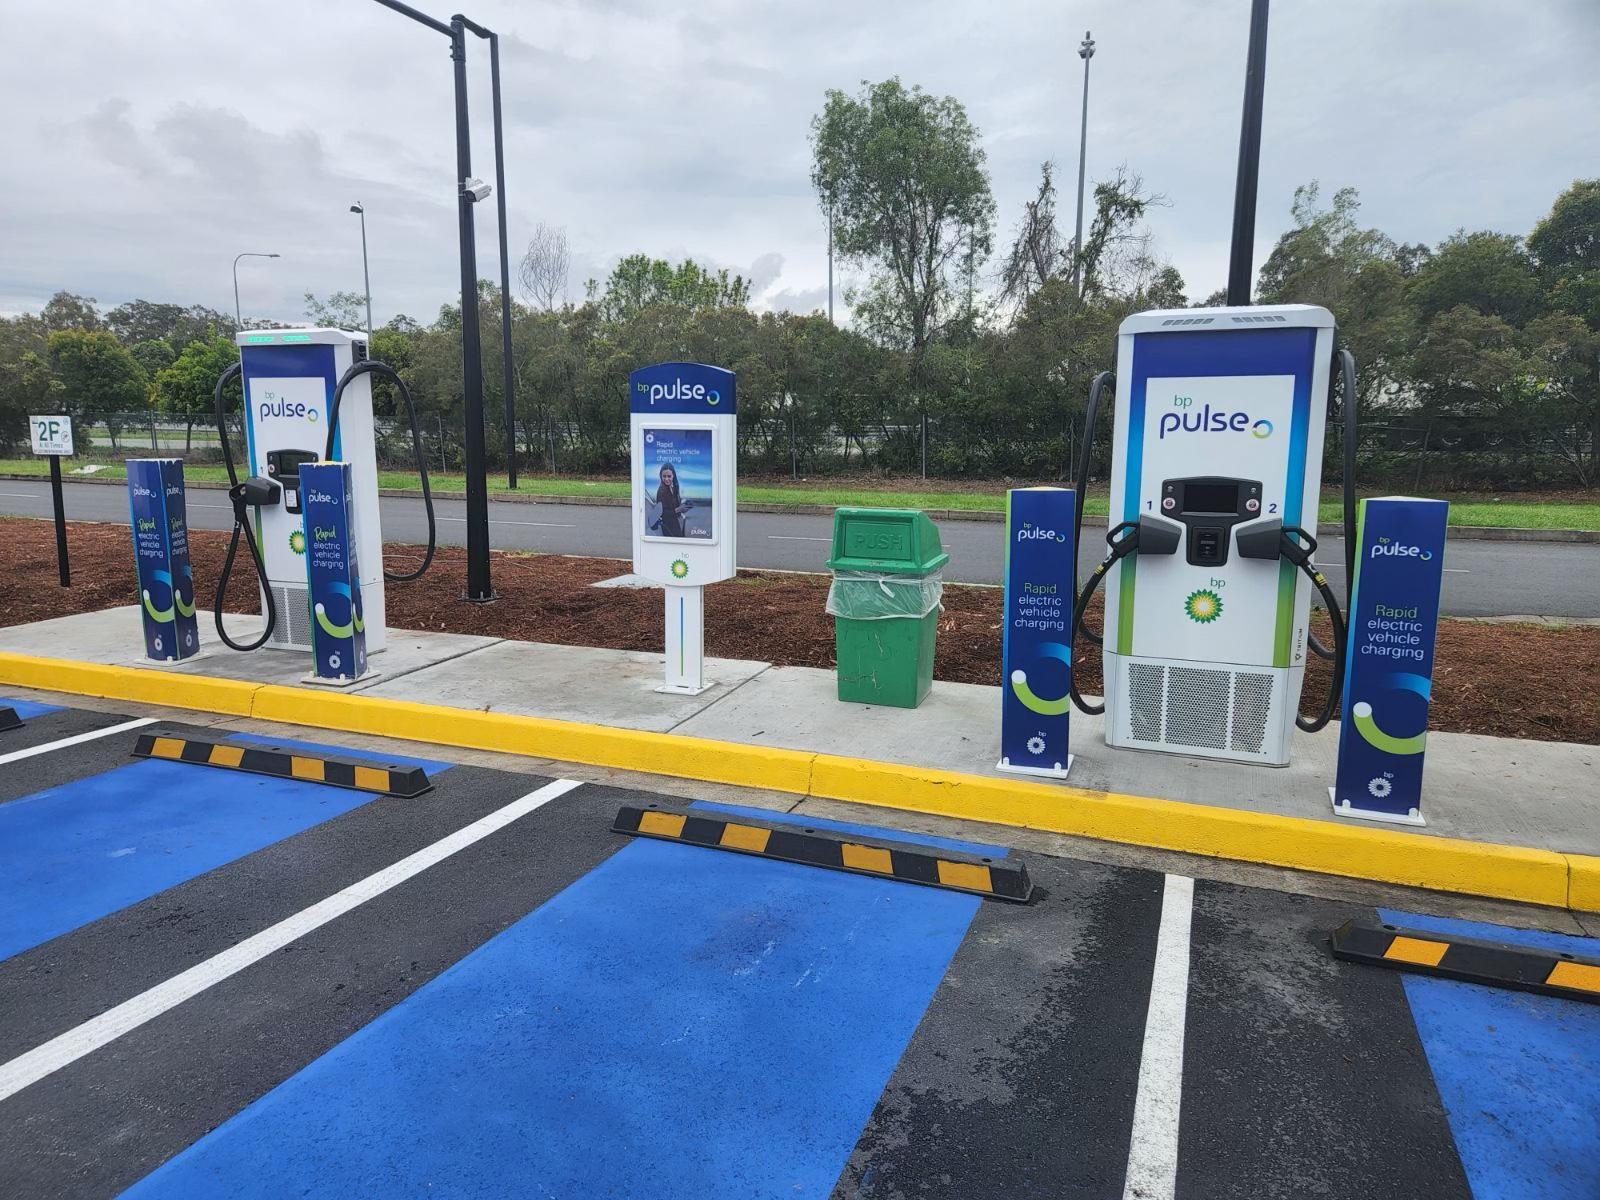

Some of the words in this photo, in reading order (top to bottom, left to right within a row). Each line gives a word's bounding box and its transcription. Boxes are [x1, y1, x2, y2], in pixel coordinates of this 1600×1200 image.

[264, 390, 275, 400] bp
[638, 382, 649, 394] bp
[650, 378, 705, 405] pulse
[1174, 395, 1193, 409] bp
[260, 397, 306, 423] pulse
[1159, 403, 1249, 440] pulse
[656, 441, 673, 449] Rapid
[656, 455, 682, 463] charging
[133, 486, 151, 496] pulse
[308, 491, 332, 504] pulse
[1146, 500, 1152, 511] 1
[1269, 503, 1277, 514] 2
[138, 517, 156, 531] Rapid
[314, 525, 337, 541] Rapid
[1018, 526, 1056, 542] pulse
[140, 540, 160, 549] vehicle
[313, 541, 341, 550] electric
[854, 532, 903, 551] PUSH
[139, 548, 164, 558] charging
[314, 550, 341, 559] vehicle
[1371, 541, 1420, 558] pulse
[312, 559, 344, 570] charging
[1024, 582, 1057, 595] Rapid
[1210, 577, 1226, 589] bp
[1018, 594, 1062, 606] electric
[1019, 606, 1060, 617] vehicle
[1375, 604, 1418, 619] Rapid
[1014, 618, 1064, 631] charging
[1367, 618, 1423, 632] electric
[1367, 631, 1420, 645] vehicle
[1361, 643, 1424, 661] charging
[1383, 771, 1394, 779] bp
